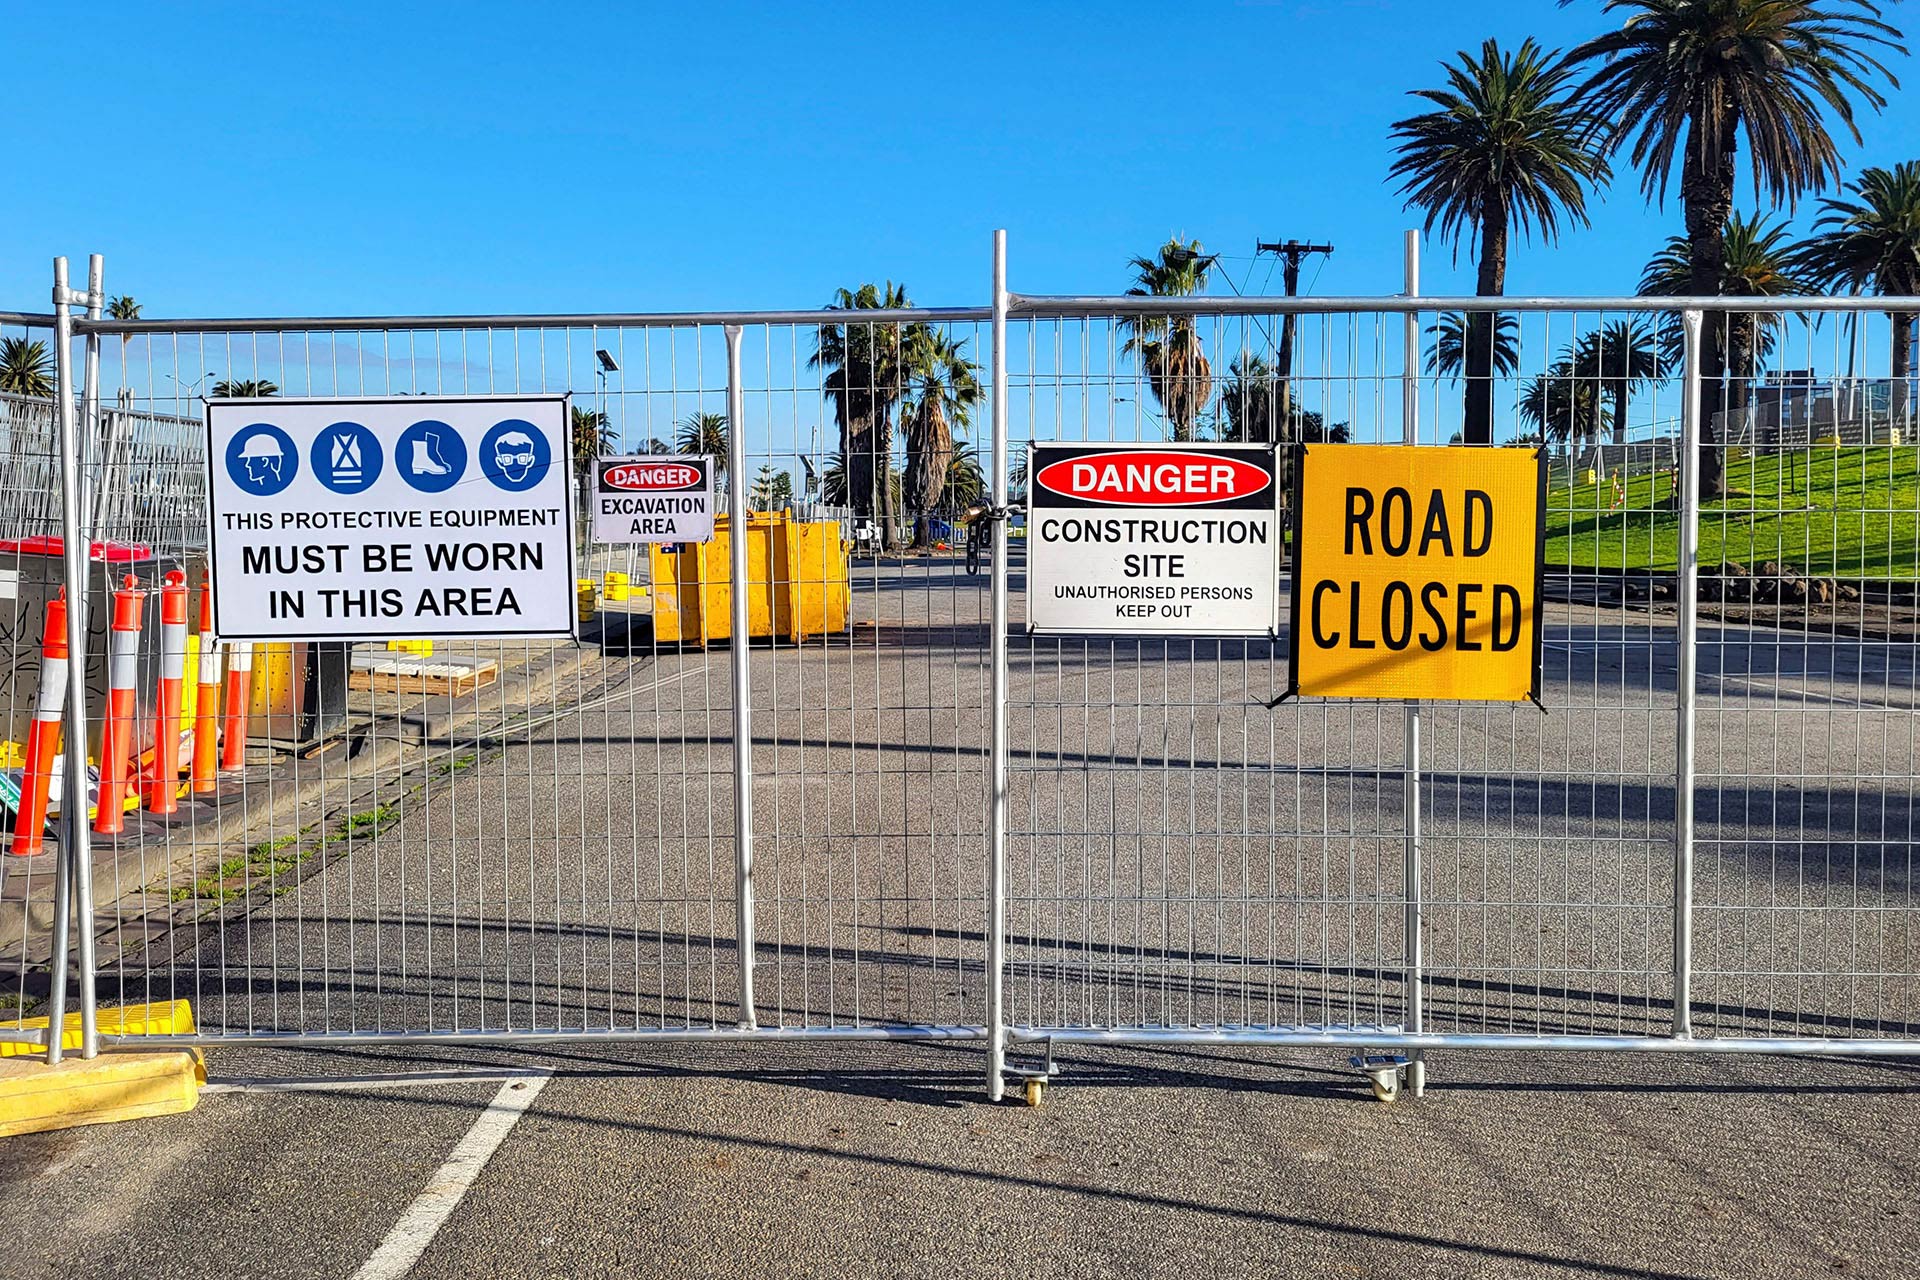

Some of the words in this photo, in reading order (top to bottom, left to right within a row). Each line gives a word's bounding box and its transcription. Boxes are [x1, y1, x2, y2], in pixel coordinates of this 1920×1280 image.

[614, 468, 692, 486] DANGER
[1072, 464, 1236, 494] DANGER
[601, 497, 705, 515] EXCAVATION
[222, 512, 274, 530] THIS
[281, 510, 423, 530] PROTECTIVE
[429, 508, 561, 529] EQUIPMENT
[629, 518, 677, 535] AREA
[1041, 518, 1267, 544] CONSTRUCTION
[1344, 486, 1493, 558] ROAD
[242, 544, 350, 575] MUST
[362, 544, 413, 573] BE
[424, 542, 543, 572] WORN
[1123, 554, 1185, 578] SITE
[269, 590, 305, 619] IN
[317, 588, 404, 618] THIS
[414, 587, 522, 617] AREA
[1054, 585, 1176, 600] UNAUTHORISED
[1180, 586, 1253, 600] PERSONS
[1116, 604, 1157, 618] KEEP
[1161, 604, 1193, 618] OUT
[1311, 579, 1522, 653] CLOSED
